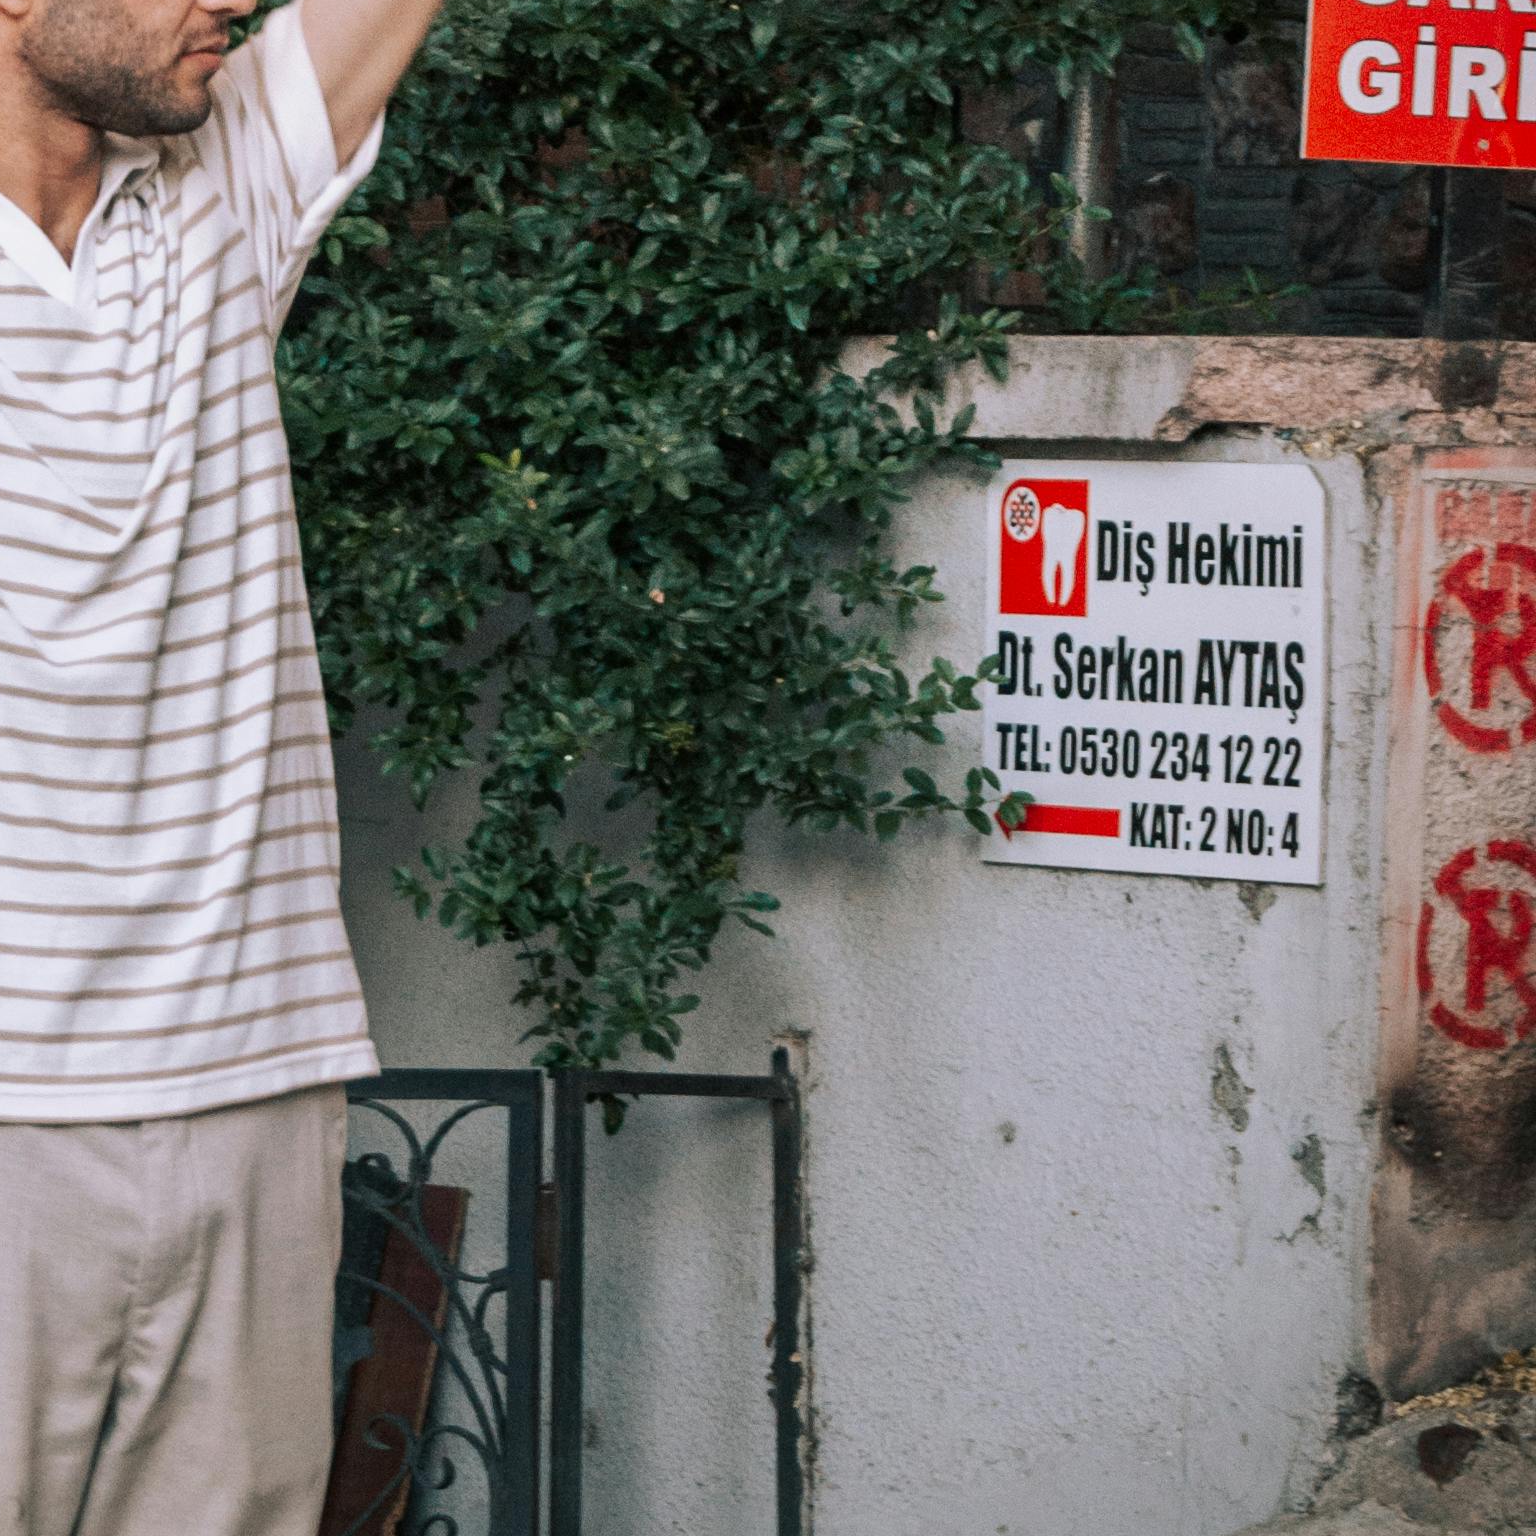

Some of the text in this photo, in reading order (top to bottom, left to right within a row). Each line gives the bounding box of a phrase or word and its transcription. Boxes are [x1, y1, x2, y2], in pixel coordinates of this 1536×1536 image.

[1097, 520, 1304, 597] Diş Hekimi
[997, 631, 1306, 725] Dt. Serkan AYTAŞ
[996, 722, 1303, 788] TEL: 0530 234 12 22
[1129, 802, 1299, 858] KAT: 2 NO: 4
